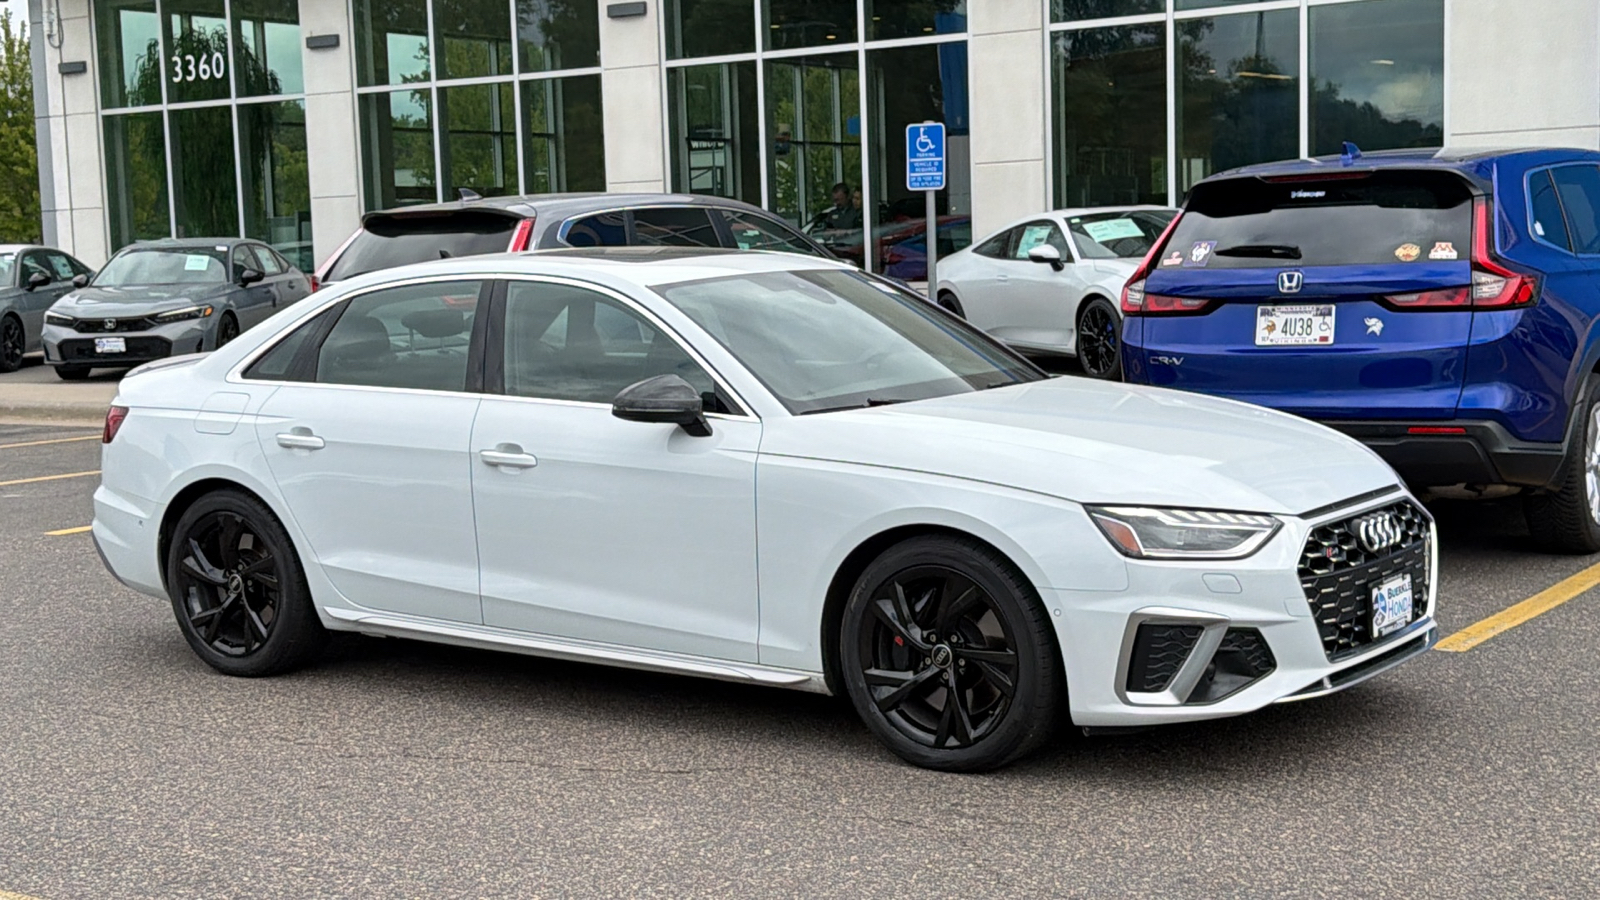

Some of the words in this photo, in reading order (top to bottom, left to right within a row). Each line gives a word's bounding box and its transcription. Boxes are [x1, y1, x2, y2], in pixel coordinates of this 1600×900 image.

[171, 51, 225, 83] 3360
[1281, 317, 1313, 337] 4U38
[1150, 356, 1185, 366] CR-V
[1387, 581, 1411, 600] BUERKLE
[1387, 596, 1411, 620] HONDA
